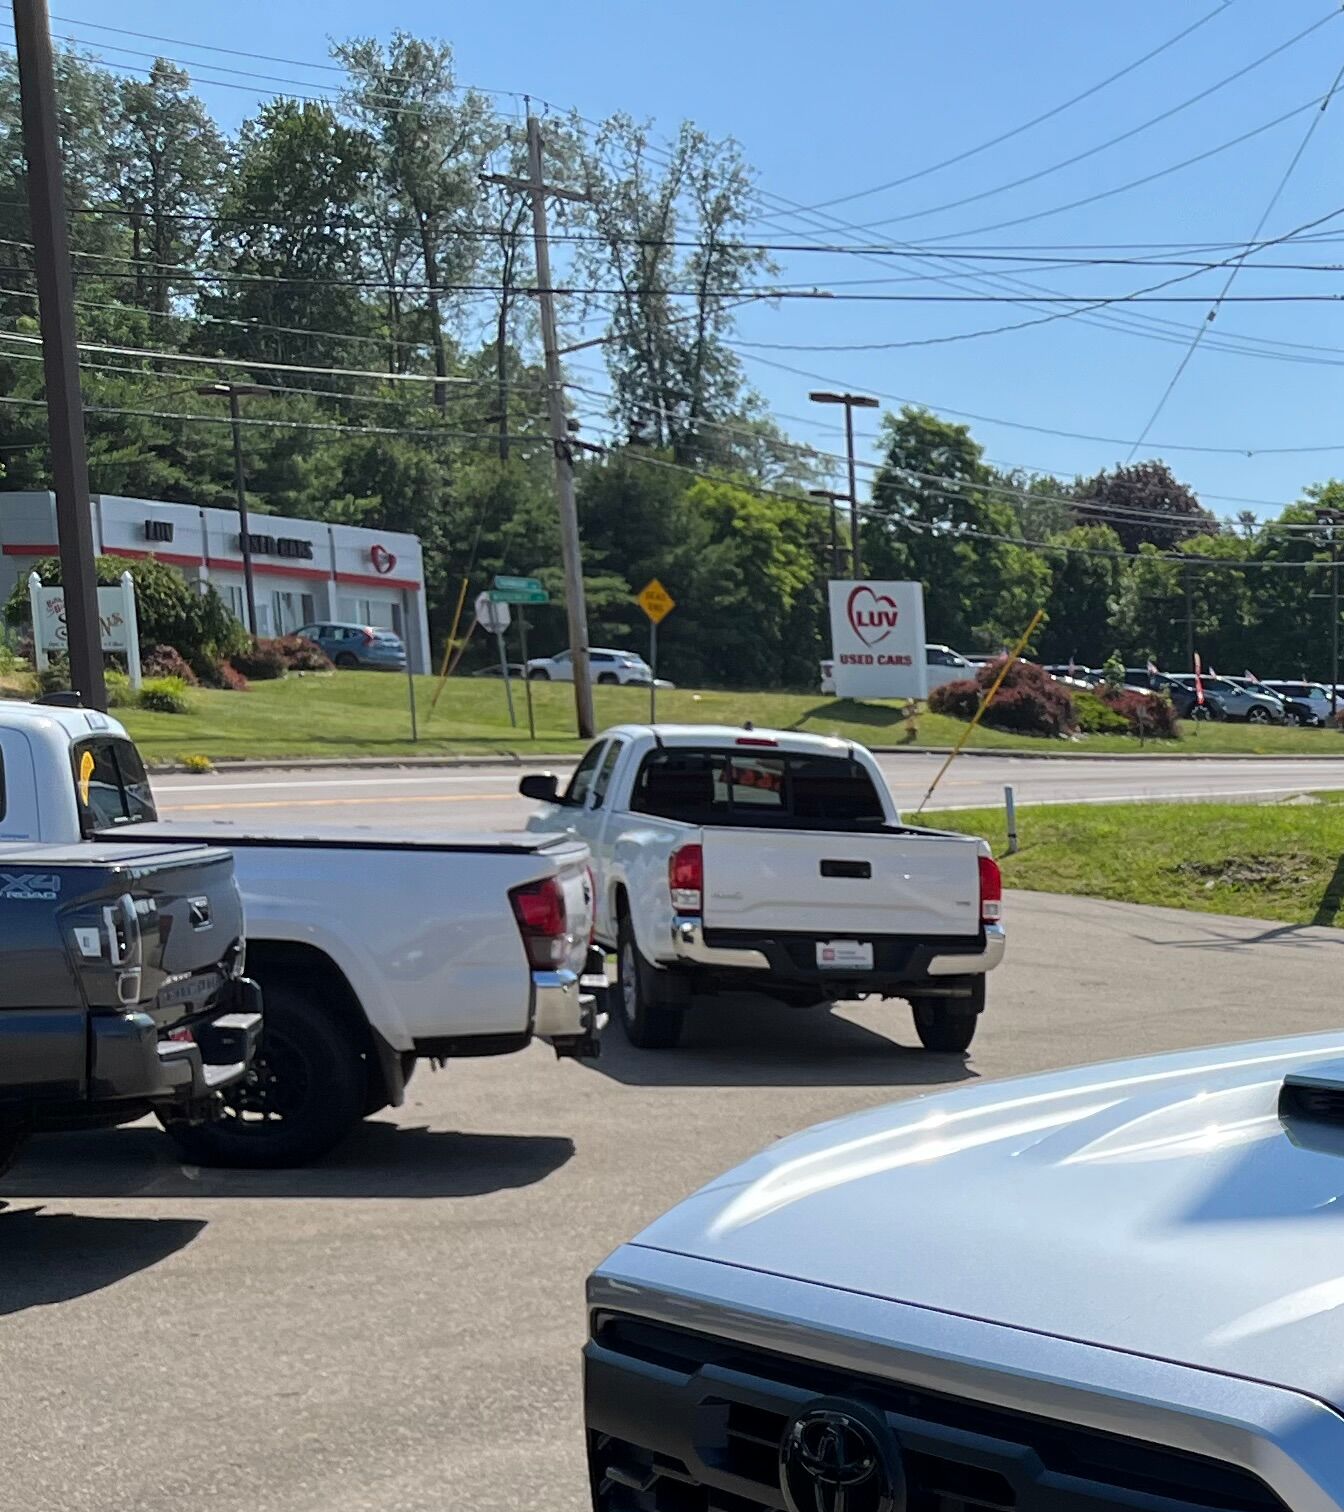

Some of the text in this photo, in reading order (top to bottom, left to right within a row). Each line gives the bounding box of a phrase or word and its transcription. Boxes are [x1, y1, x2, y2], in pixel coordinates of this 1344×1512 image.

[856, 610, 898, 627] LUV
[840, 653, 912, 666] USED CARS
[0, 873, 61, 892] X4
[6, 890, 57, 899] ROAD
